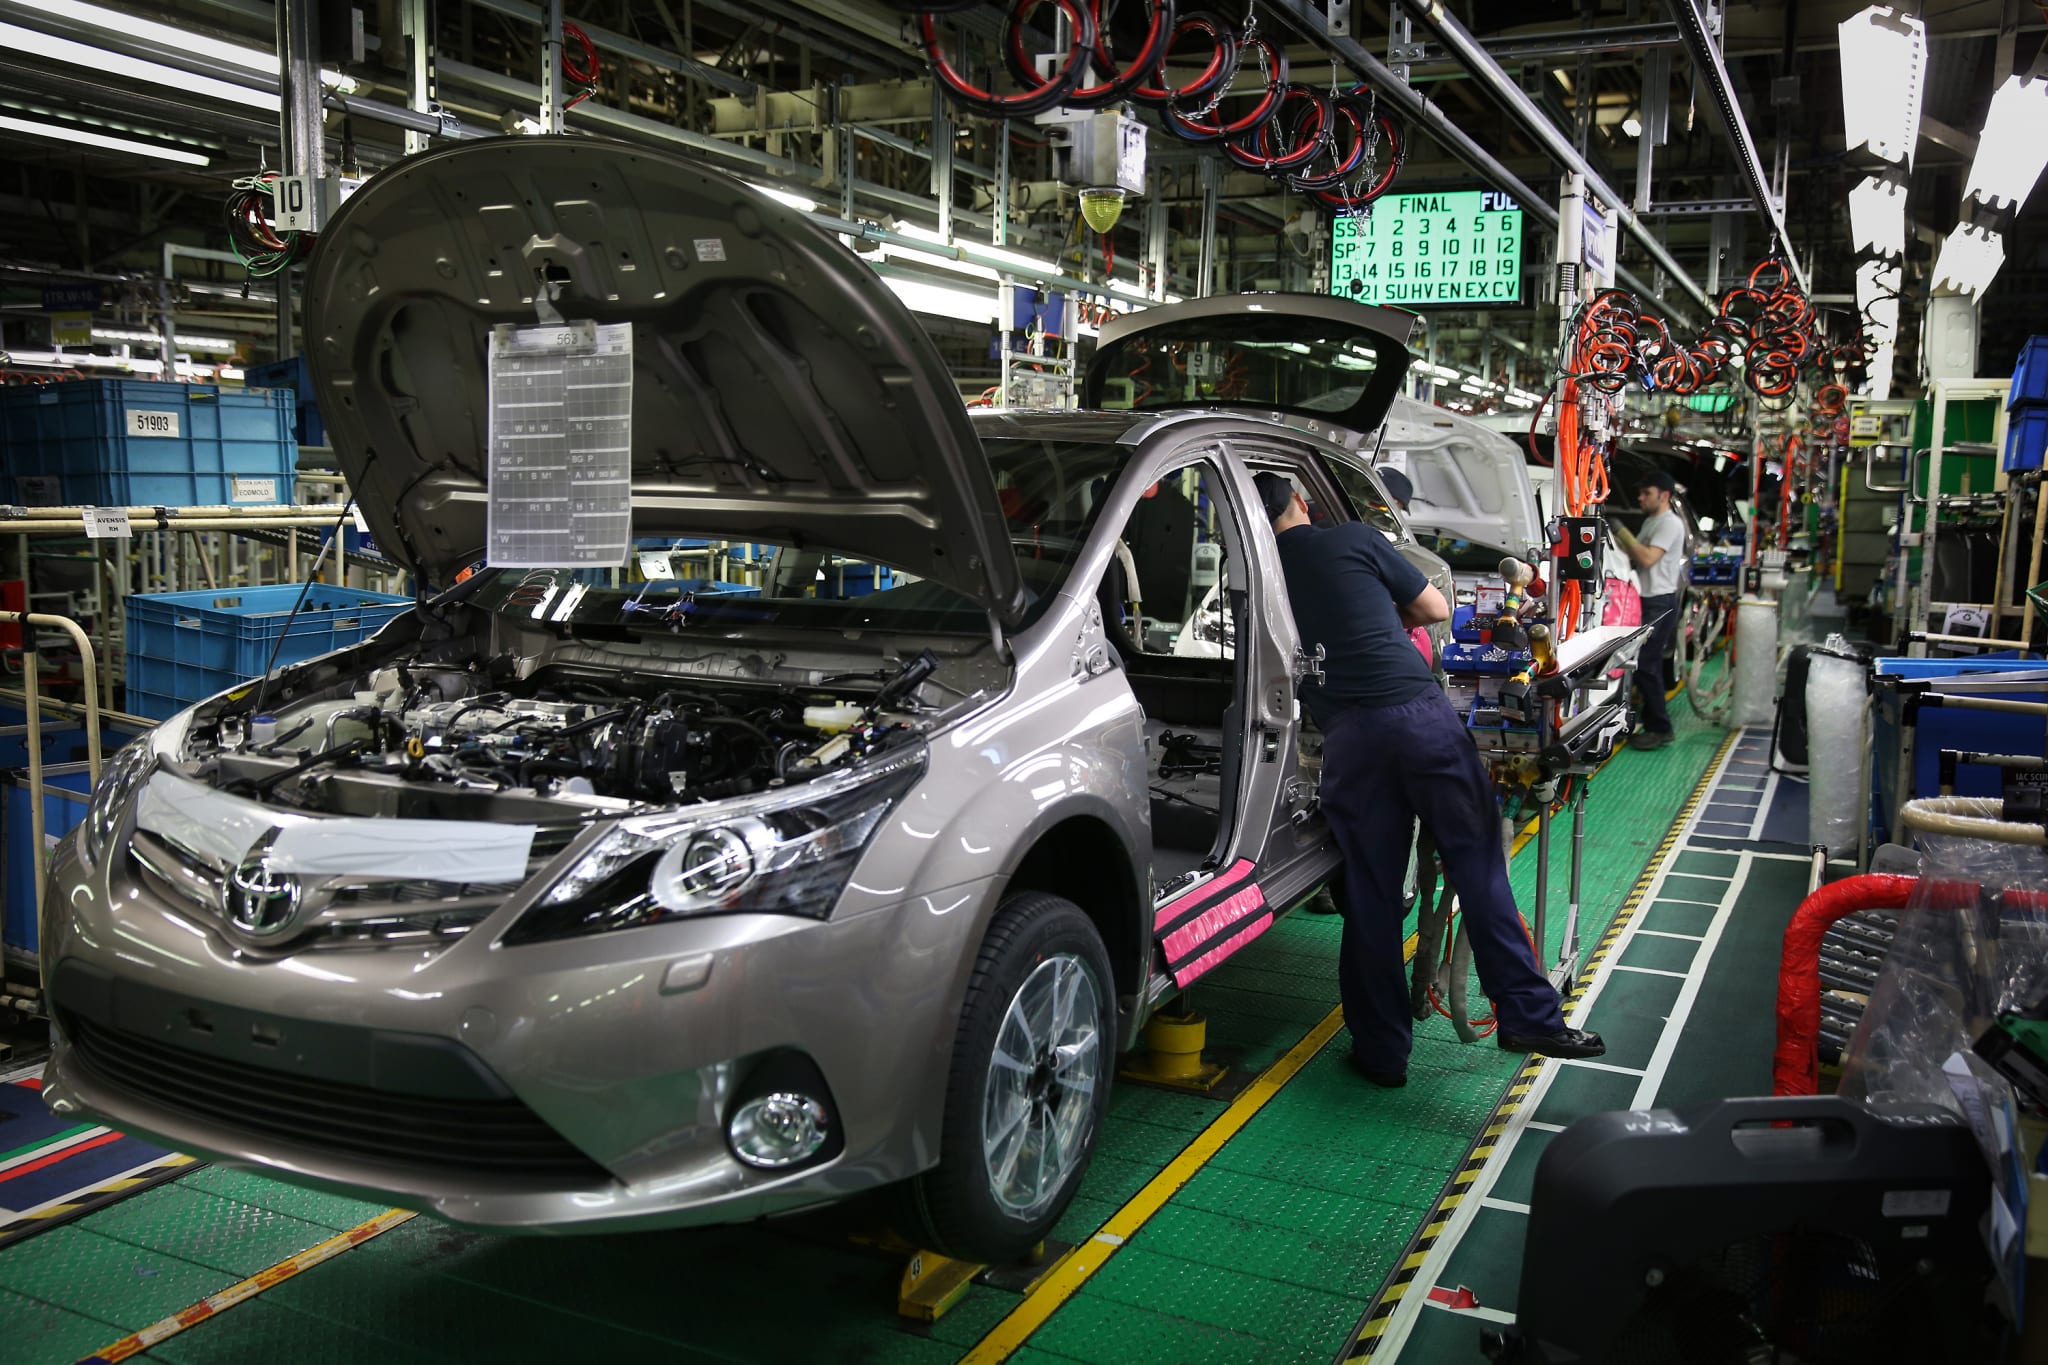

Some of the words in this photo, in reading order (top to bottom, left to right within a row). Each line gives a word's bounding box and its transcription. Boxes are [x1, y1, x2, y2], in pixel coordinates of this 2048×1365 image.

[280, 180, 303, 213] 10
[1400, 196, 1452, 214] FINAL
[290, 216, 296, 227] R
[1335, 222, 1357, 238] SS
[1393, 220, 1404, 235] 2
[1419, 219, 1430, 234] 3
[1446, 217, 1457, 233] 4
[1474, 216, 1485, 232] 5
[1501, 215, 1512, 231] 6
[1335, 243, 1356, 258] SP
[1366, 242, 1376, 257] 7
[1392, 241, 1403, 257] 8
[1418, 240, 1429, 256] 9
[1442, 239, 1460, 255] 10
[1473, 238, 1485, 254] 11
[1497, 238, 1514, 253] 12
[1336, 264, 1352, 280] 13
[1363, 264, 1378, 279] 14
[1388, 263, 1404, 278] 15
[1415, 262, 1431, 277] 16
[1442, 261, 1458, 276] 17
[1470, 260, 1486, 276] 18
[1496, 259, 1513, 275] 19
[1361, 285, 1378, 300] 21
[556, 333, 579, 345] 563
[137, 414, 169, 431] 51903
